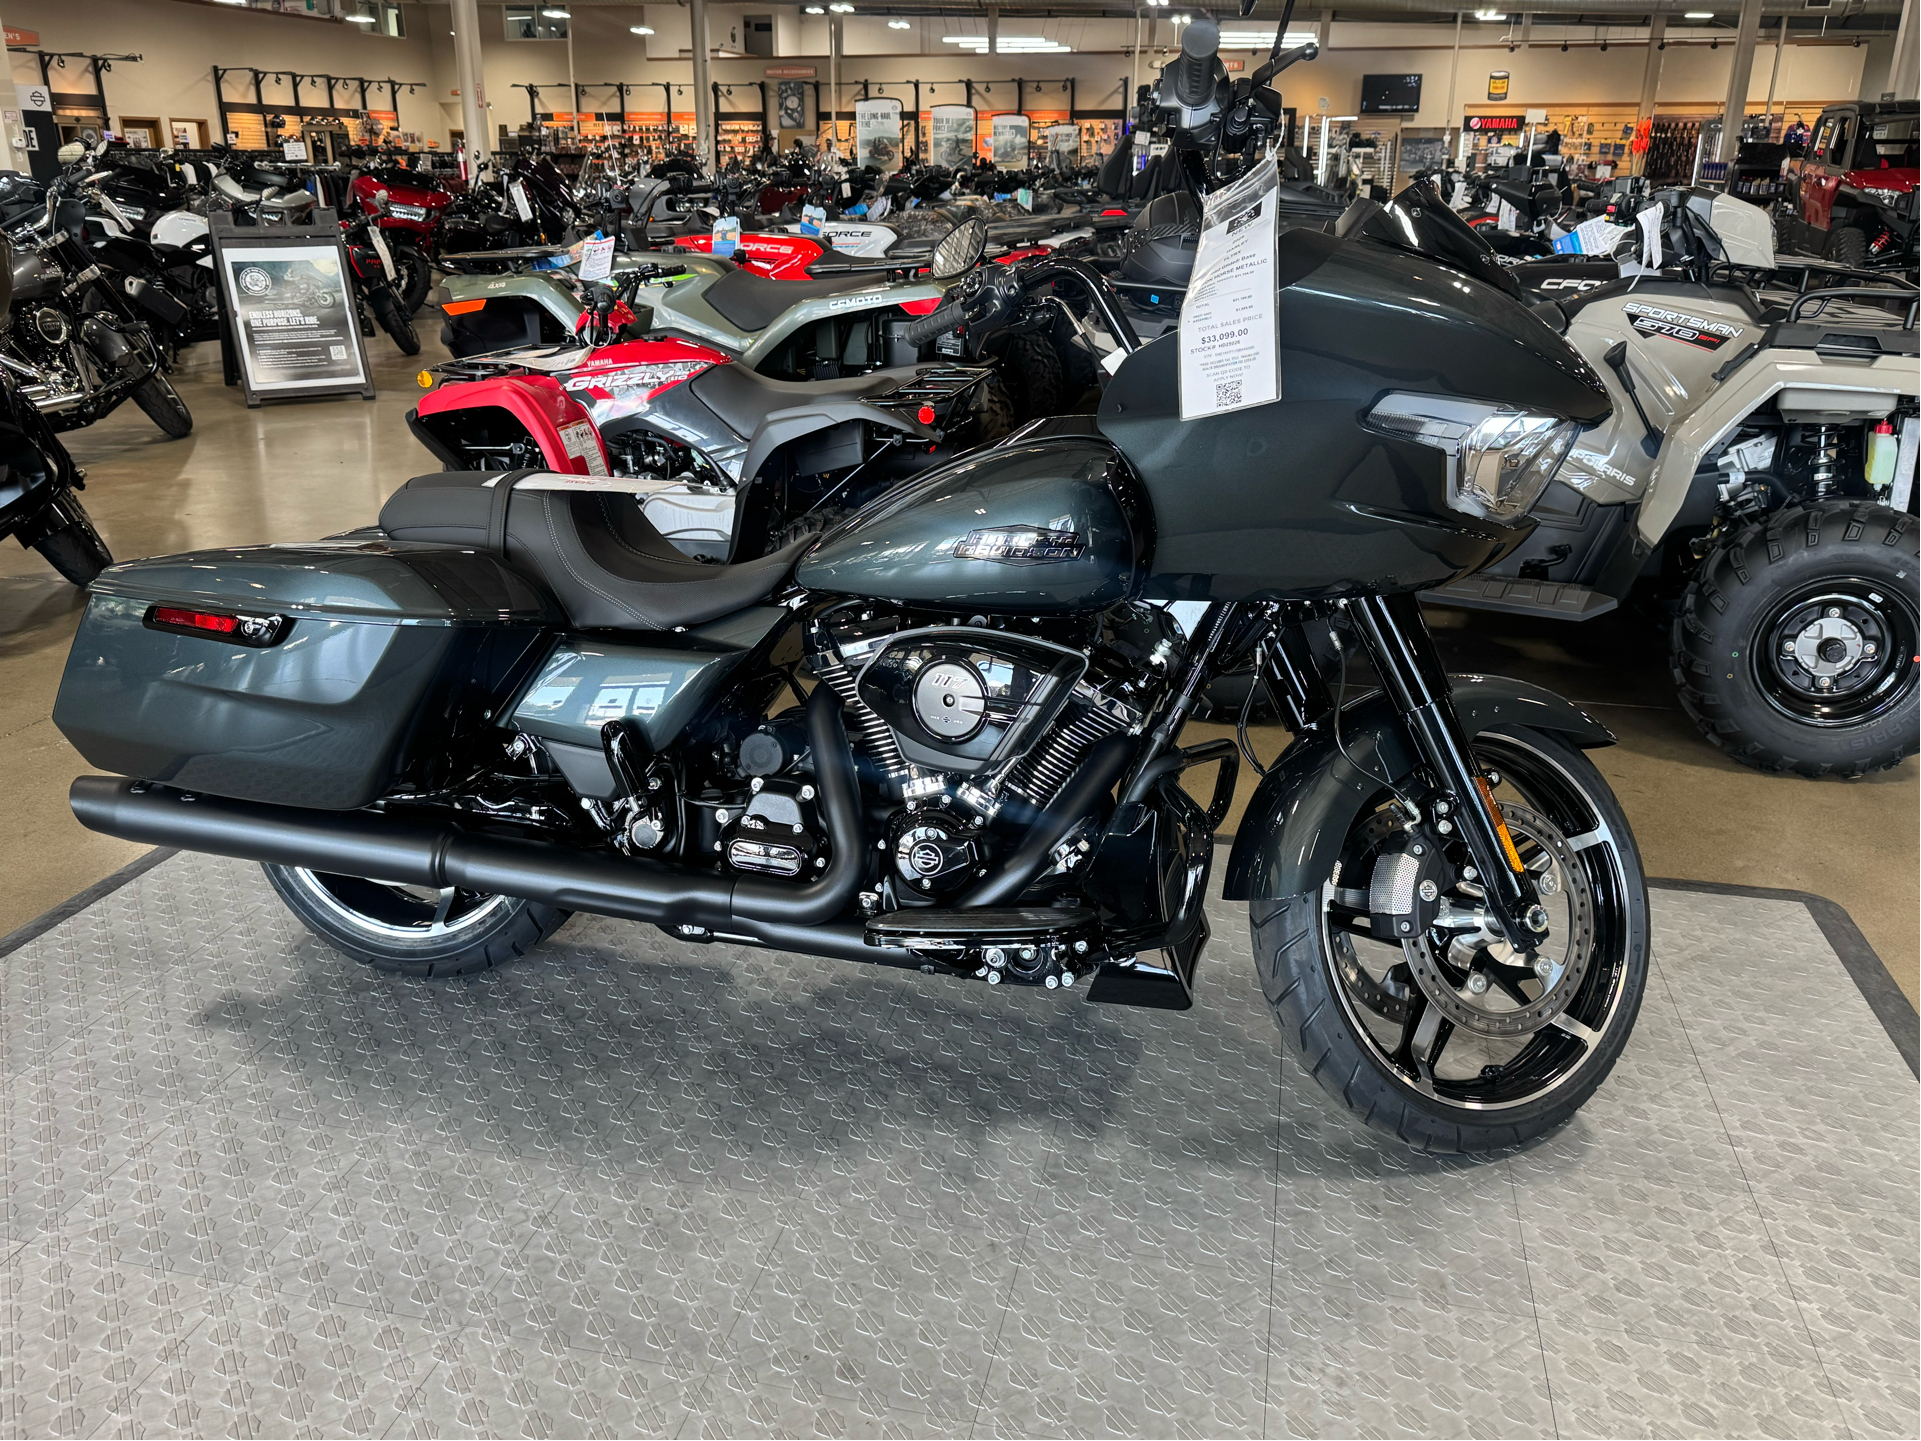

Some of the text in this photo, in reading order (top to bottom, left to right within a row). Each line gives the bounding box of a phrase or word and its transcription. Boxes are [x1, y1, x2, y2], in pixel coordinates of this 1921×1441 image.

[4, 32, 20, 40] EN'S
[1481, 118, 1517, 129] YAMAHA
[23, 129, 36, 149] DE
[1235, 258, 1268, 271] METALLIC
[829, 295, 882, 310] CFMOTO
[248, 310, 273, 320] ENDLESS
[250, 318, 263, 327] ONE
[263, 317, 290, 326] PURPOSE.
[290, 316, 305, 325] LET'S
[1622, 302, 1744, 338] SPORTSMAN
[1198, 313, 1263, 333] TOTAL SALES PRICE
[1633, 317, 1700, 341] 570
[1201, 328, 1249, 344] $33,099.00
[1190, 344, 1217, 354] STOCK#
[586, 358, 613, 368] YAMAHA
[565, 370, 674, 391] GRIZZLY
[1573, 451, 1636, 486] POLARIS
[957, 544, 1081, 559] DAVIDSON
[932, 673, 970, 689] 117
